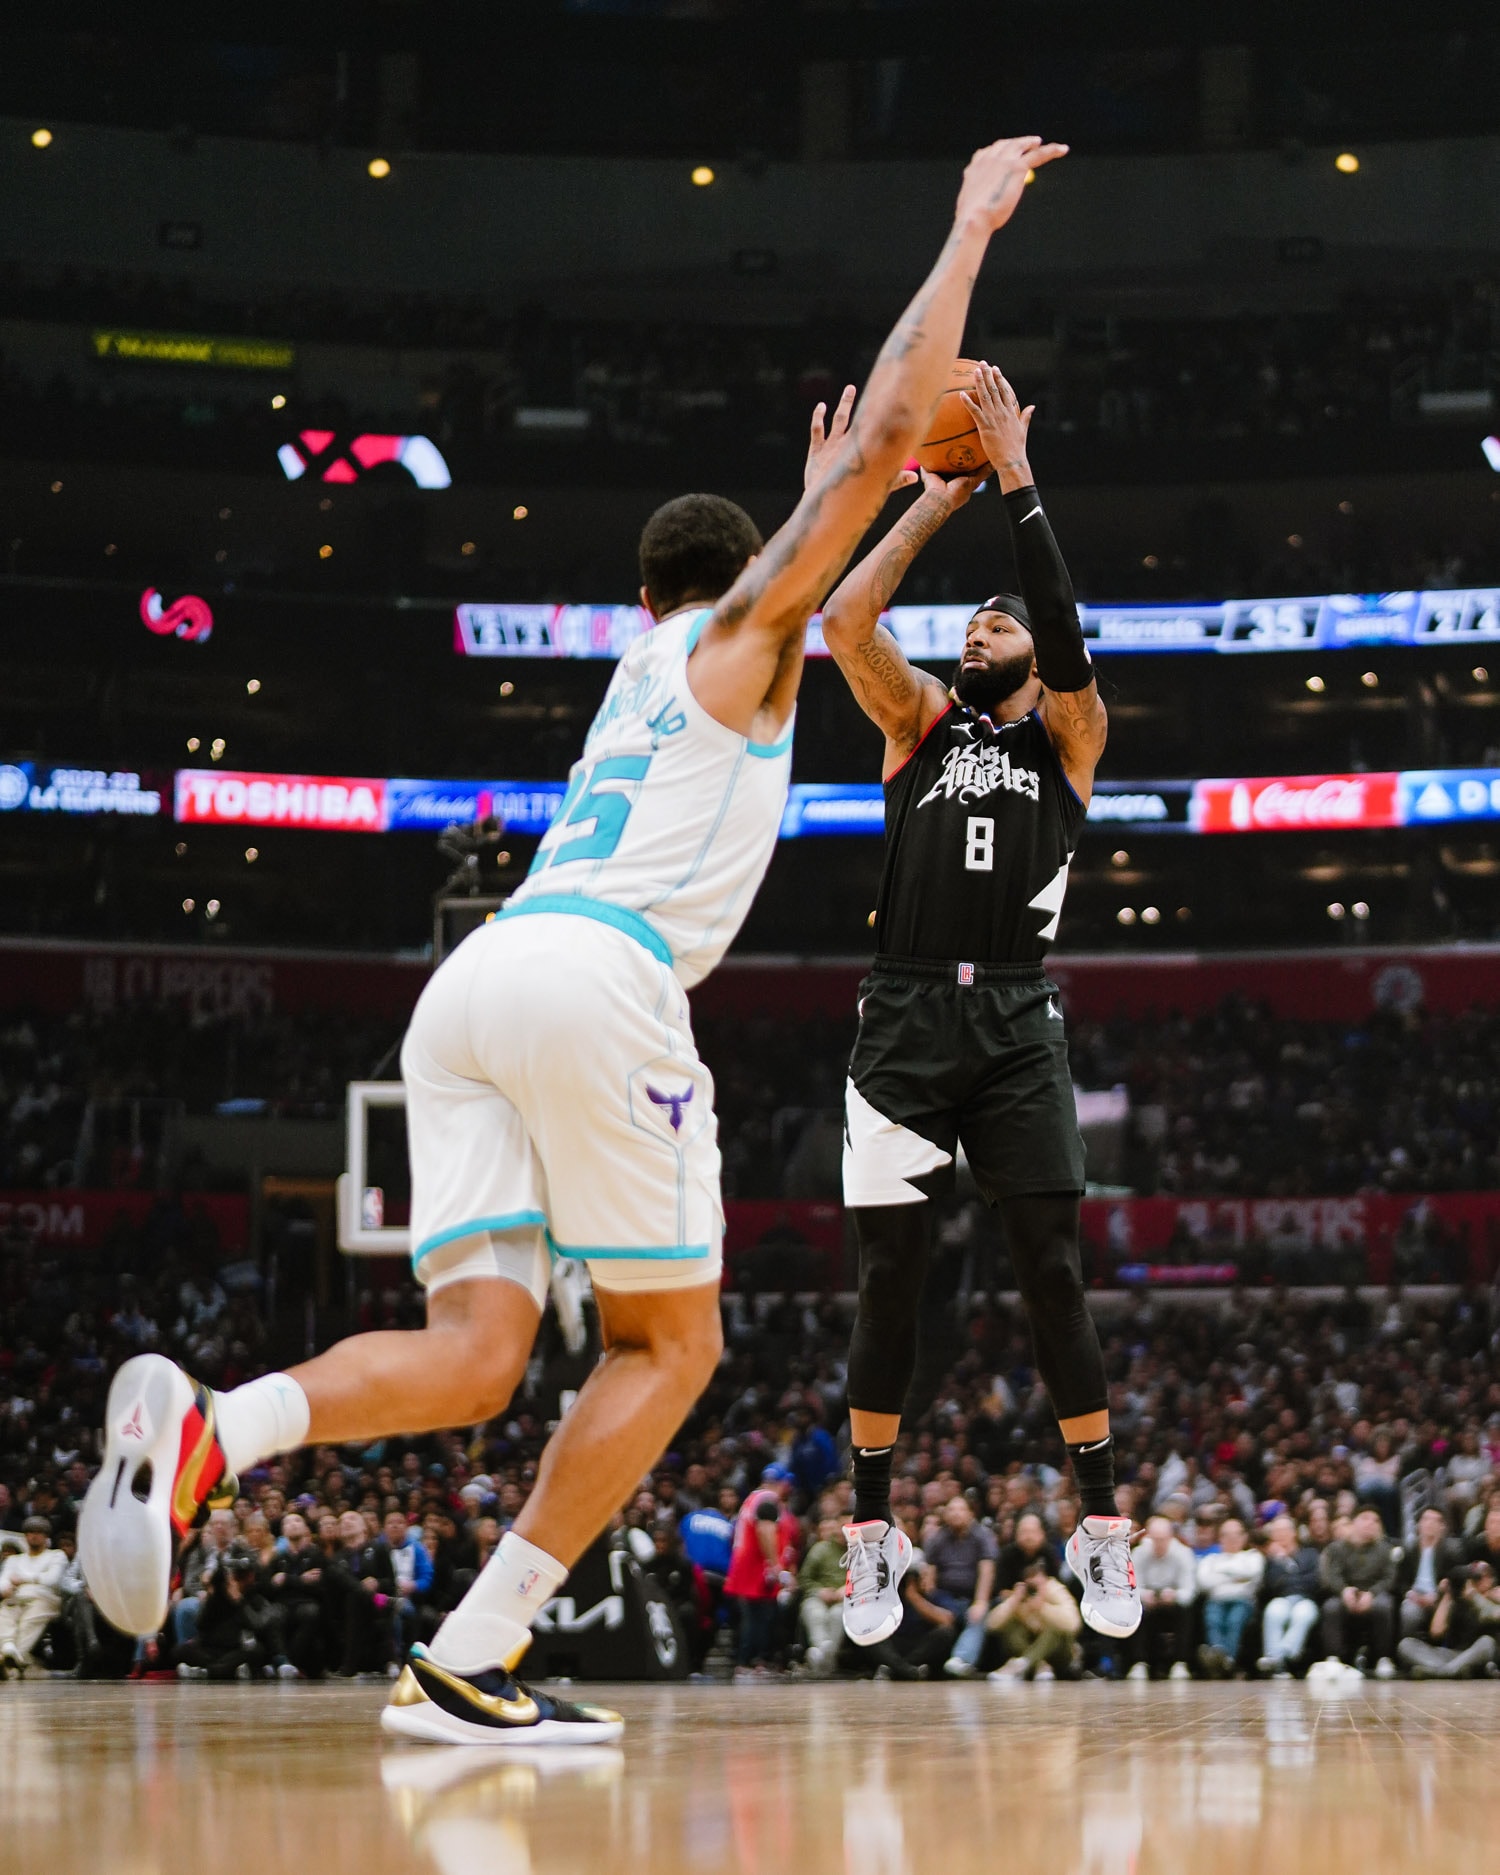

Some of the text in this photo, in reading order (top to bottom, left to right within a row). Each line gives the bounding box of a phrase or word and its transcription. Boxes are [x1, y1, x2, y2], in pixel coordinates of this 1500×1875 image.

[1248, 604, 1306, 648] 35
[917, 745, 1040, 808] Angeles
[190, 778, 377, 824] TOSHIBA
[1086, 794, 1168, 820] OYOTA
[965, 816, 995, 871] 8
